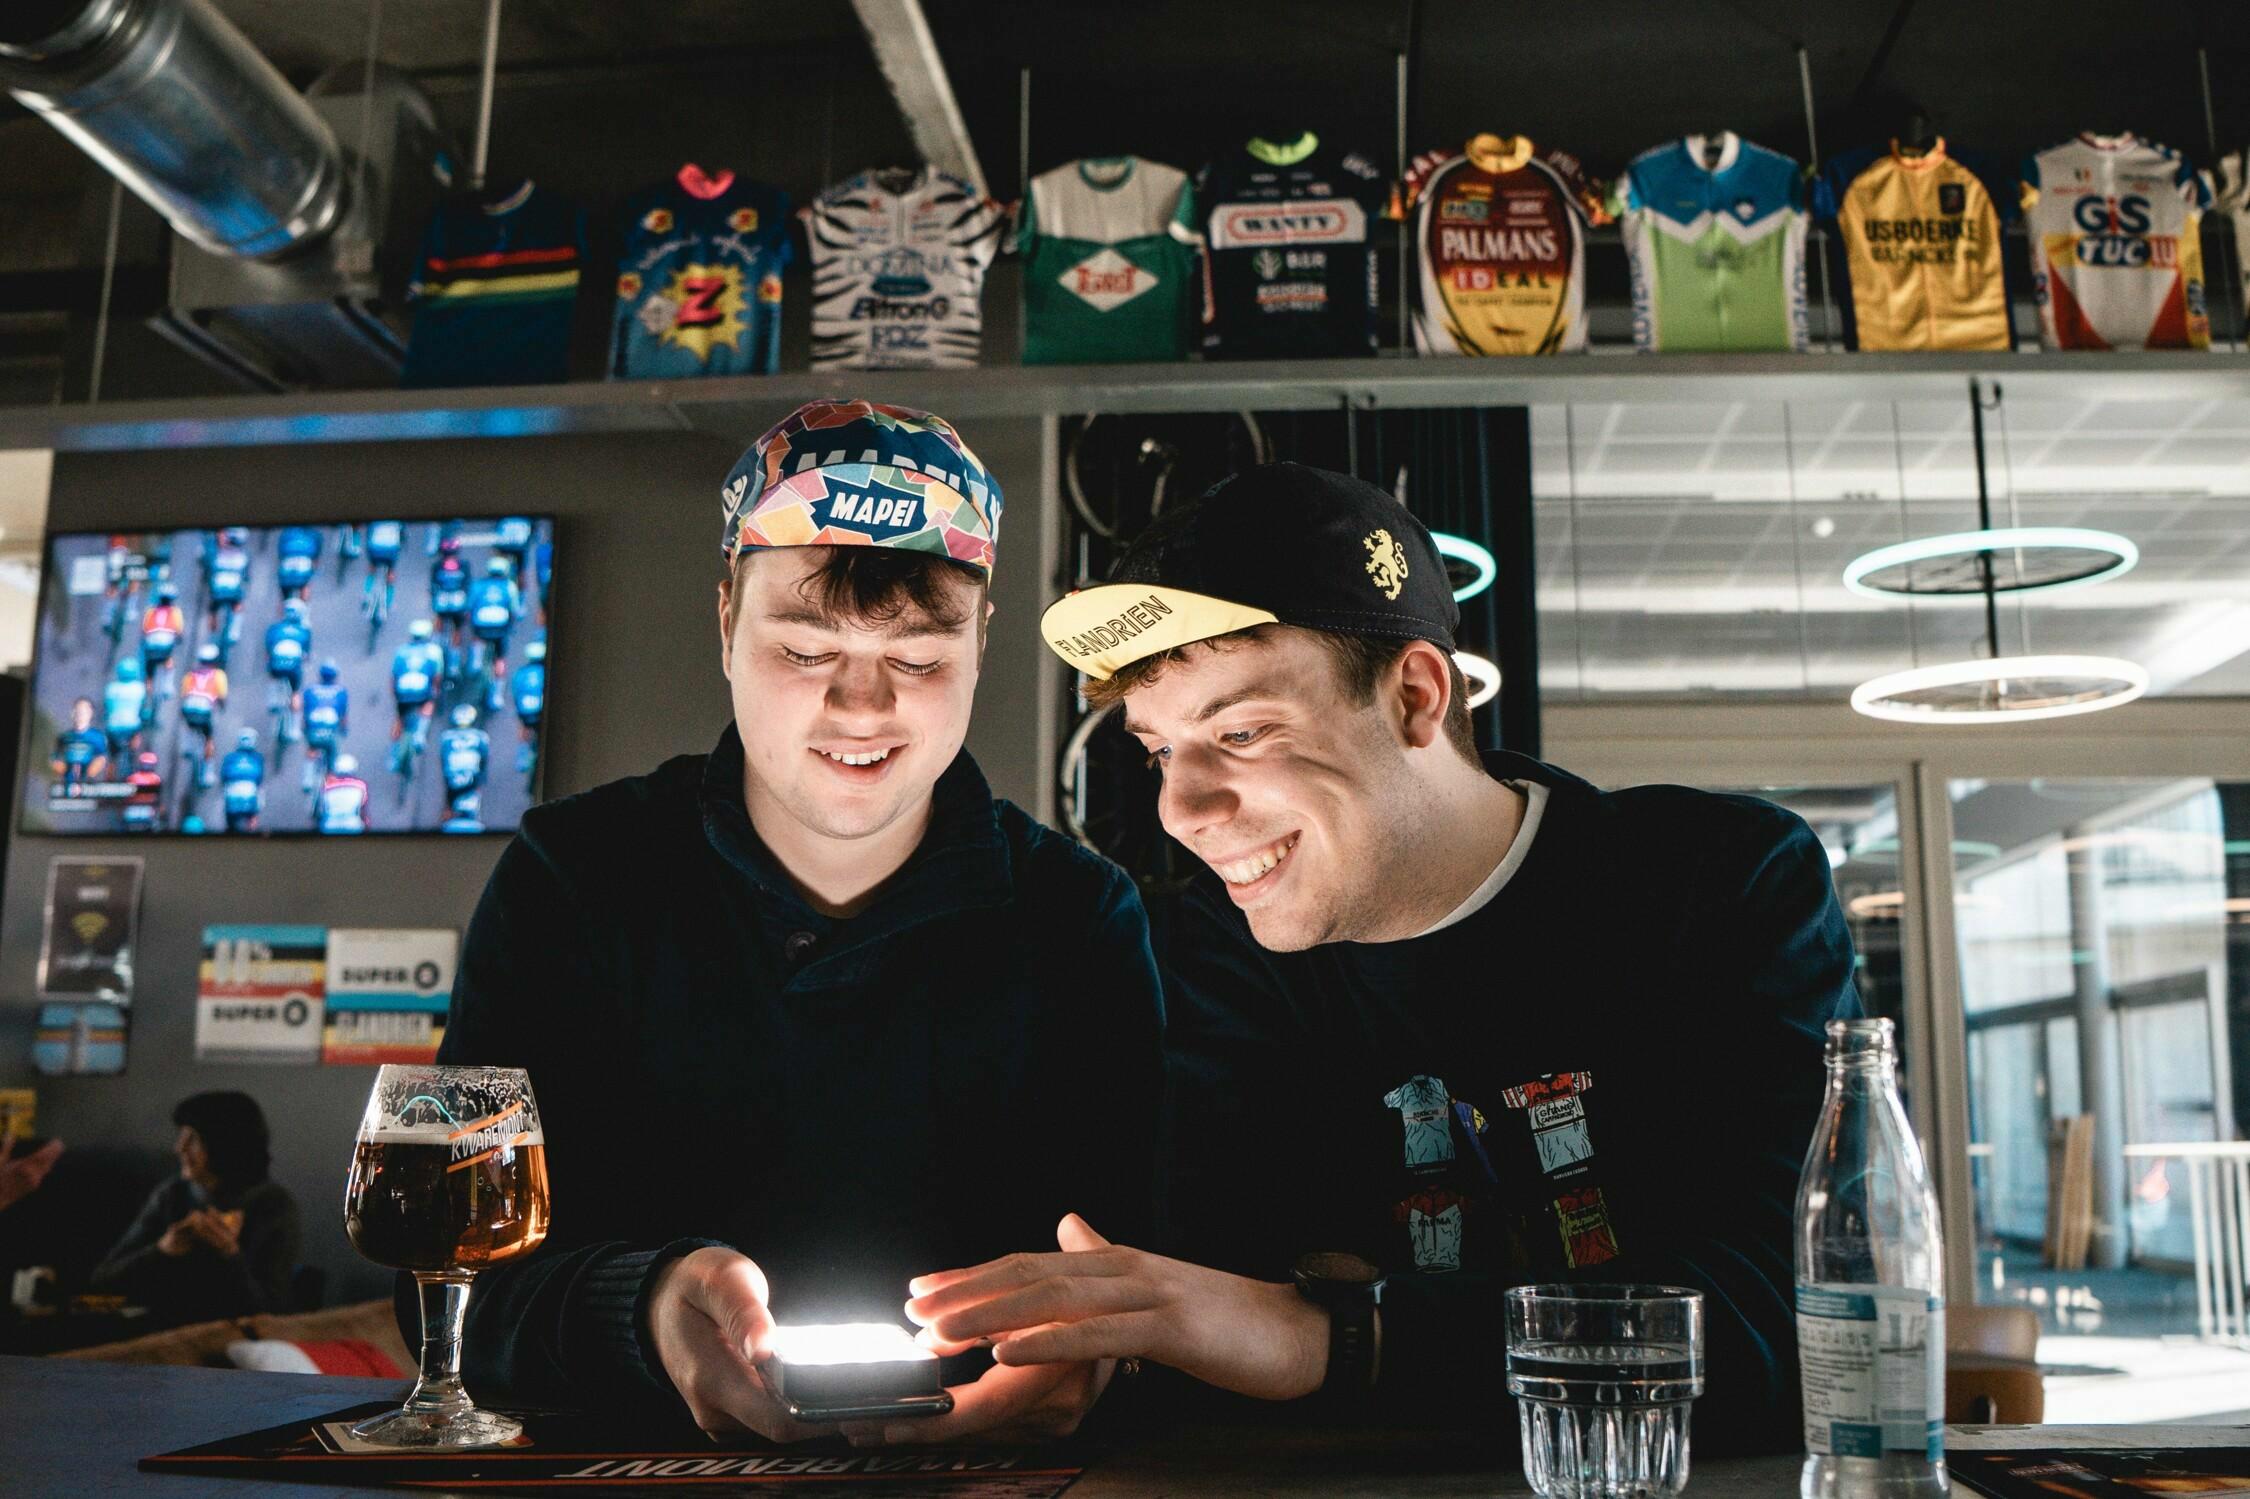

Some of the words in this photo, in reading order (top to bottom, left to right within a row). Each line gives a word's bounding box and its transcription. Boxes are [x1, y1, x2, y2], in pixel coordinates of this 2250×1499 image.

[1243, 215, 1330, 232] WANTY
[1441, 228, 1558, 261] PALMANS
[2080, 239, 2144, 264] TUC
[1456, 268, 1551, 290] IDEAL
[676, 275, 728, 328] Z
[829, 492, 918, 527] MAPEI
[1054, 594, 1173, 658] FLANDRIEN
[451, 1111, 524, 1161] KWAREMONT
